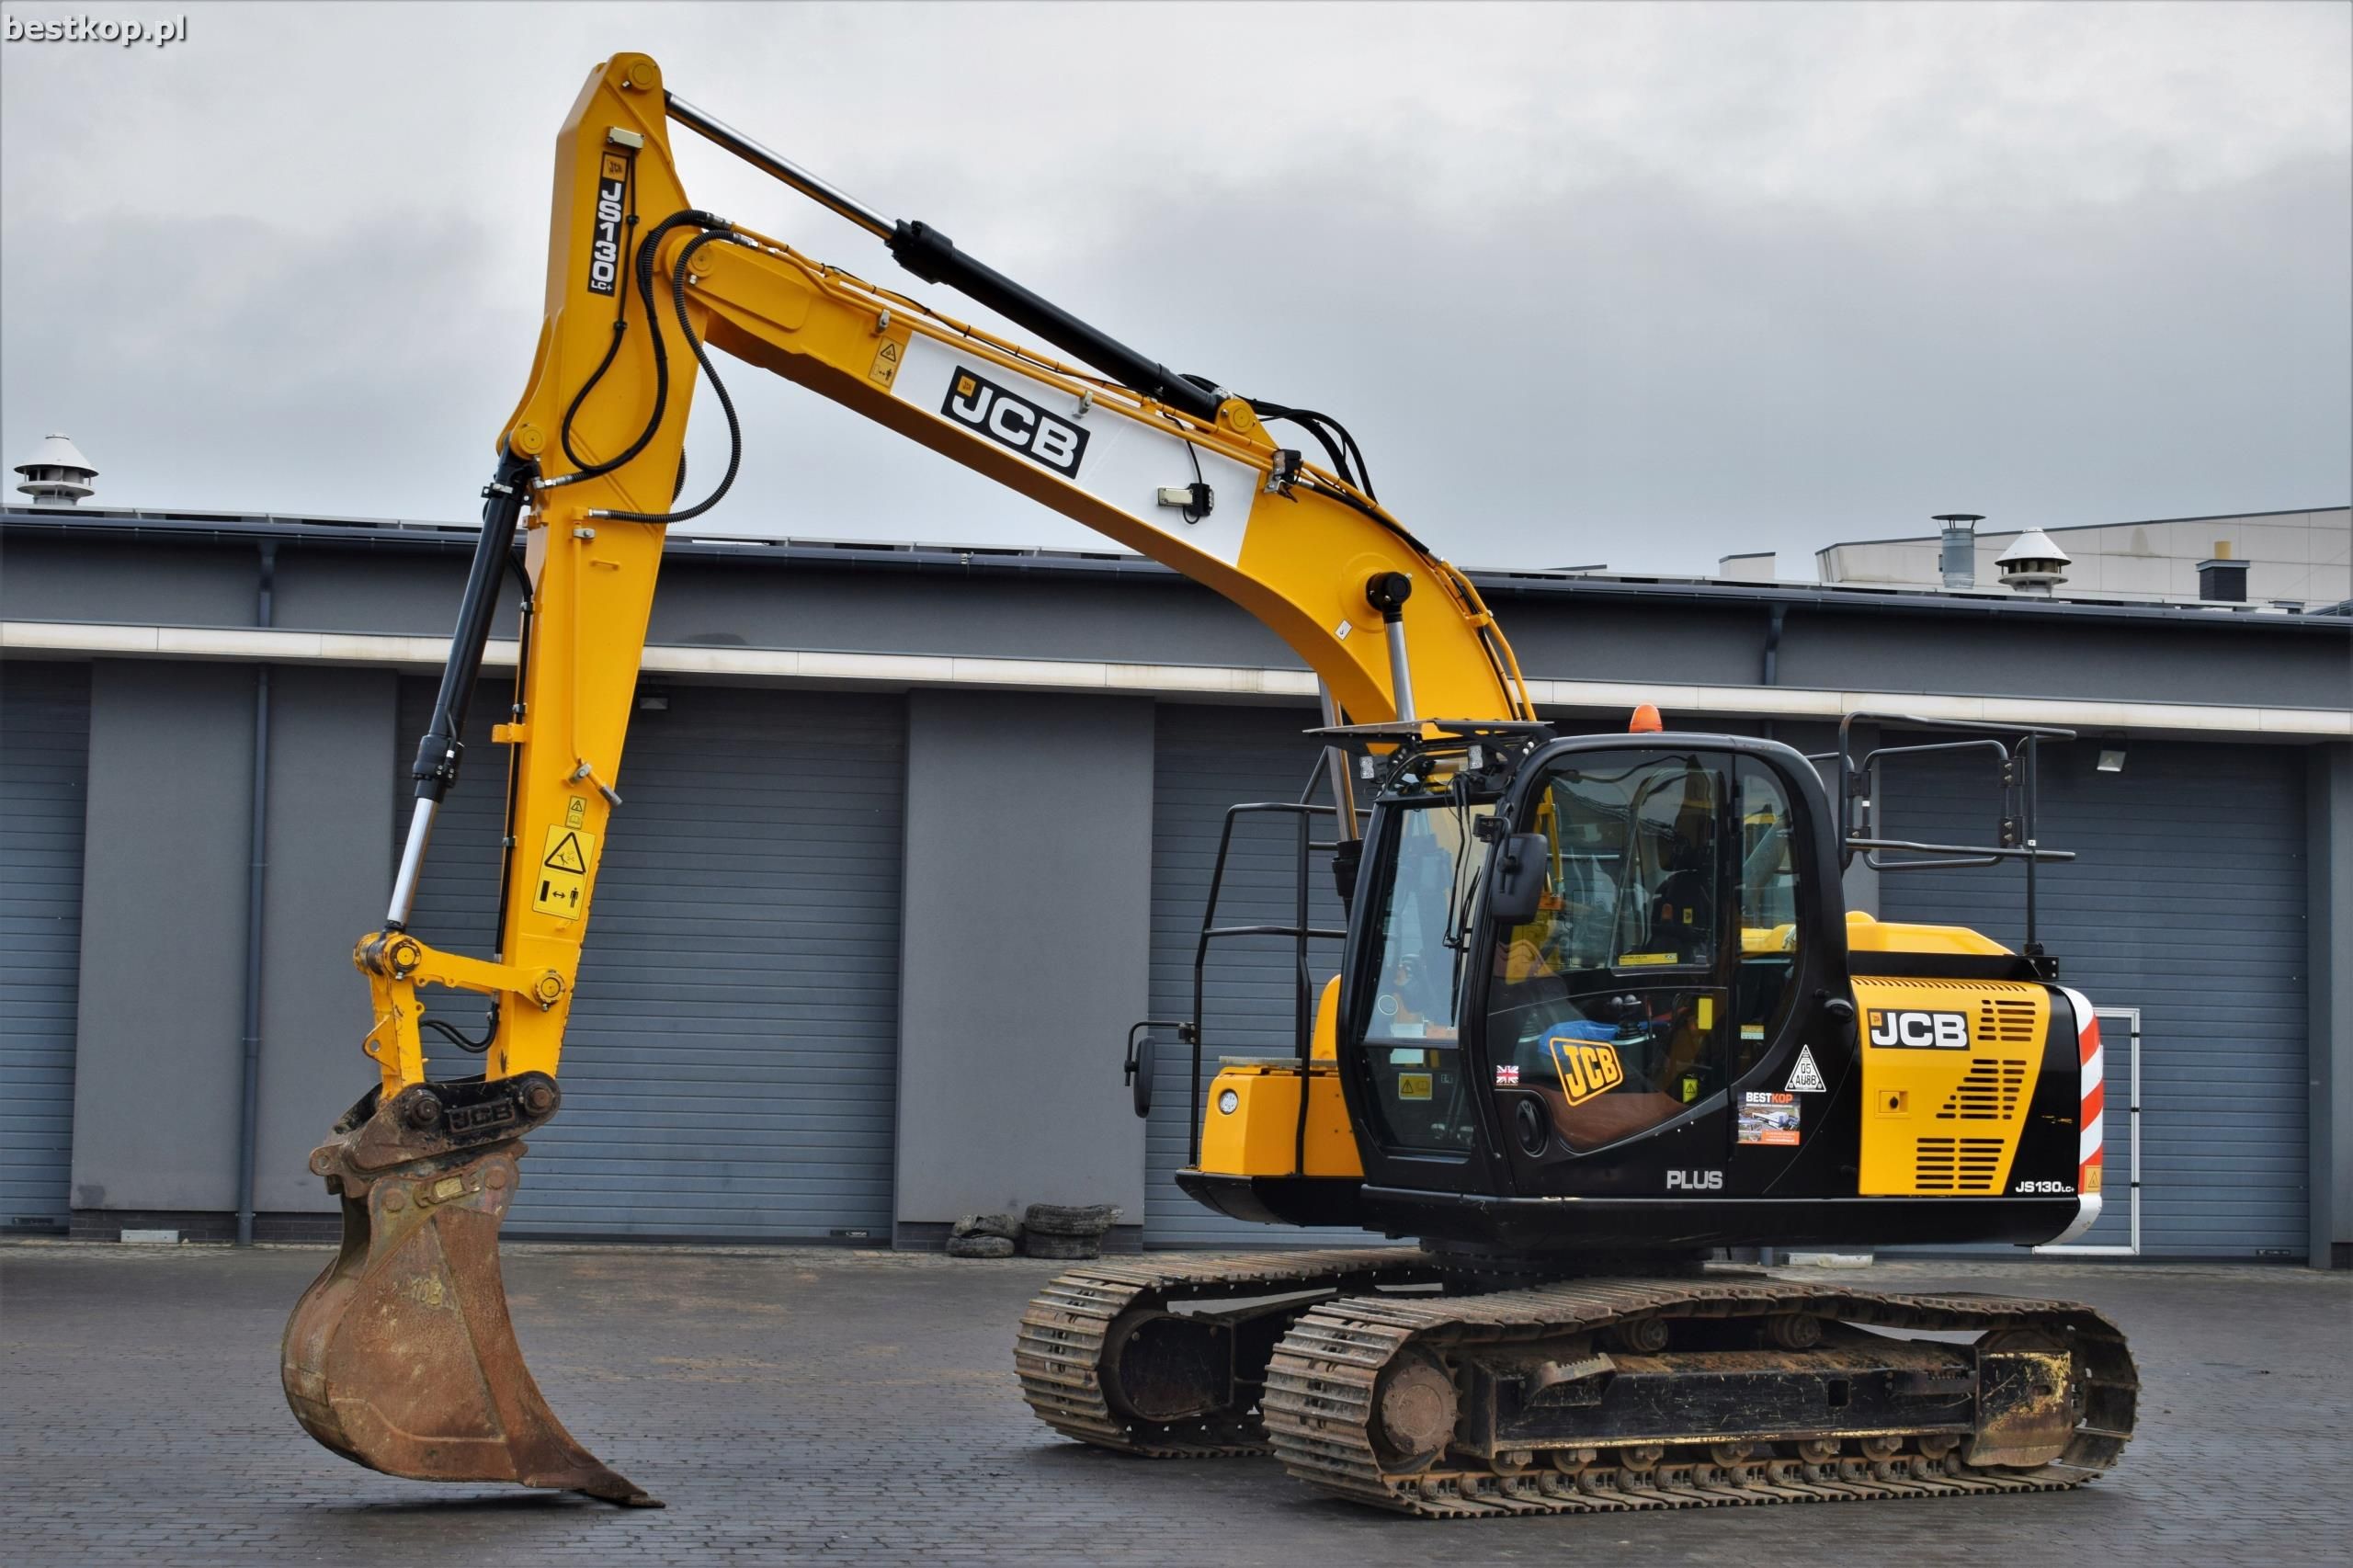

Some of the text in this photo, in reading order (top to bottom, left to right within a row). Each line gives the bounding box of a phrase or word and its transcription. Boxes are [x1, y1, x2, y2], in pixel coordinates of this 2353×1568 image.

[592, 182, 622, 283] JS130
[951, 386, 1078, 468] JCB
[1870, 1012, 1968, 1048] JCB
[1563, 1044, 1618, 1097] JCB
[1801, 1062, 1812, 1074] 05
[1745, 1091, 1793, 1104] BESTKOP
[1666, 1170, 1723, 1189] PLUS
